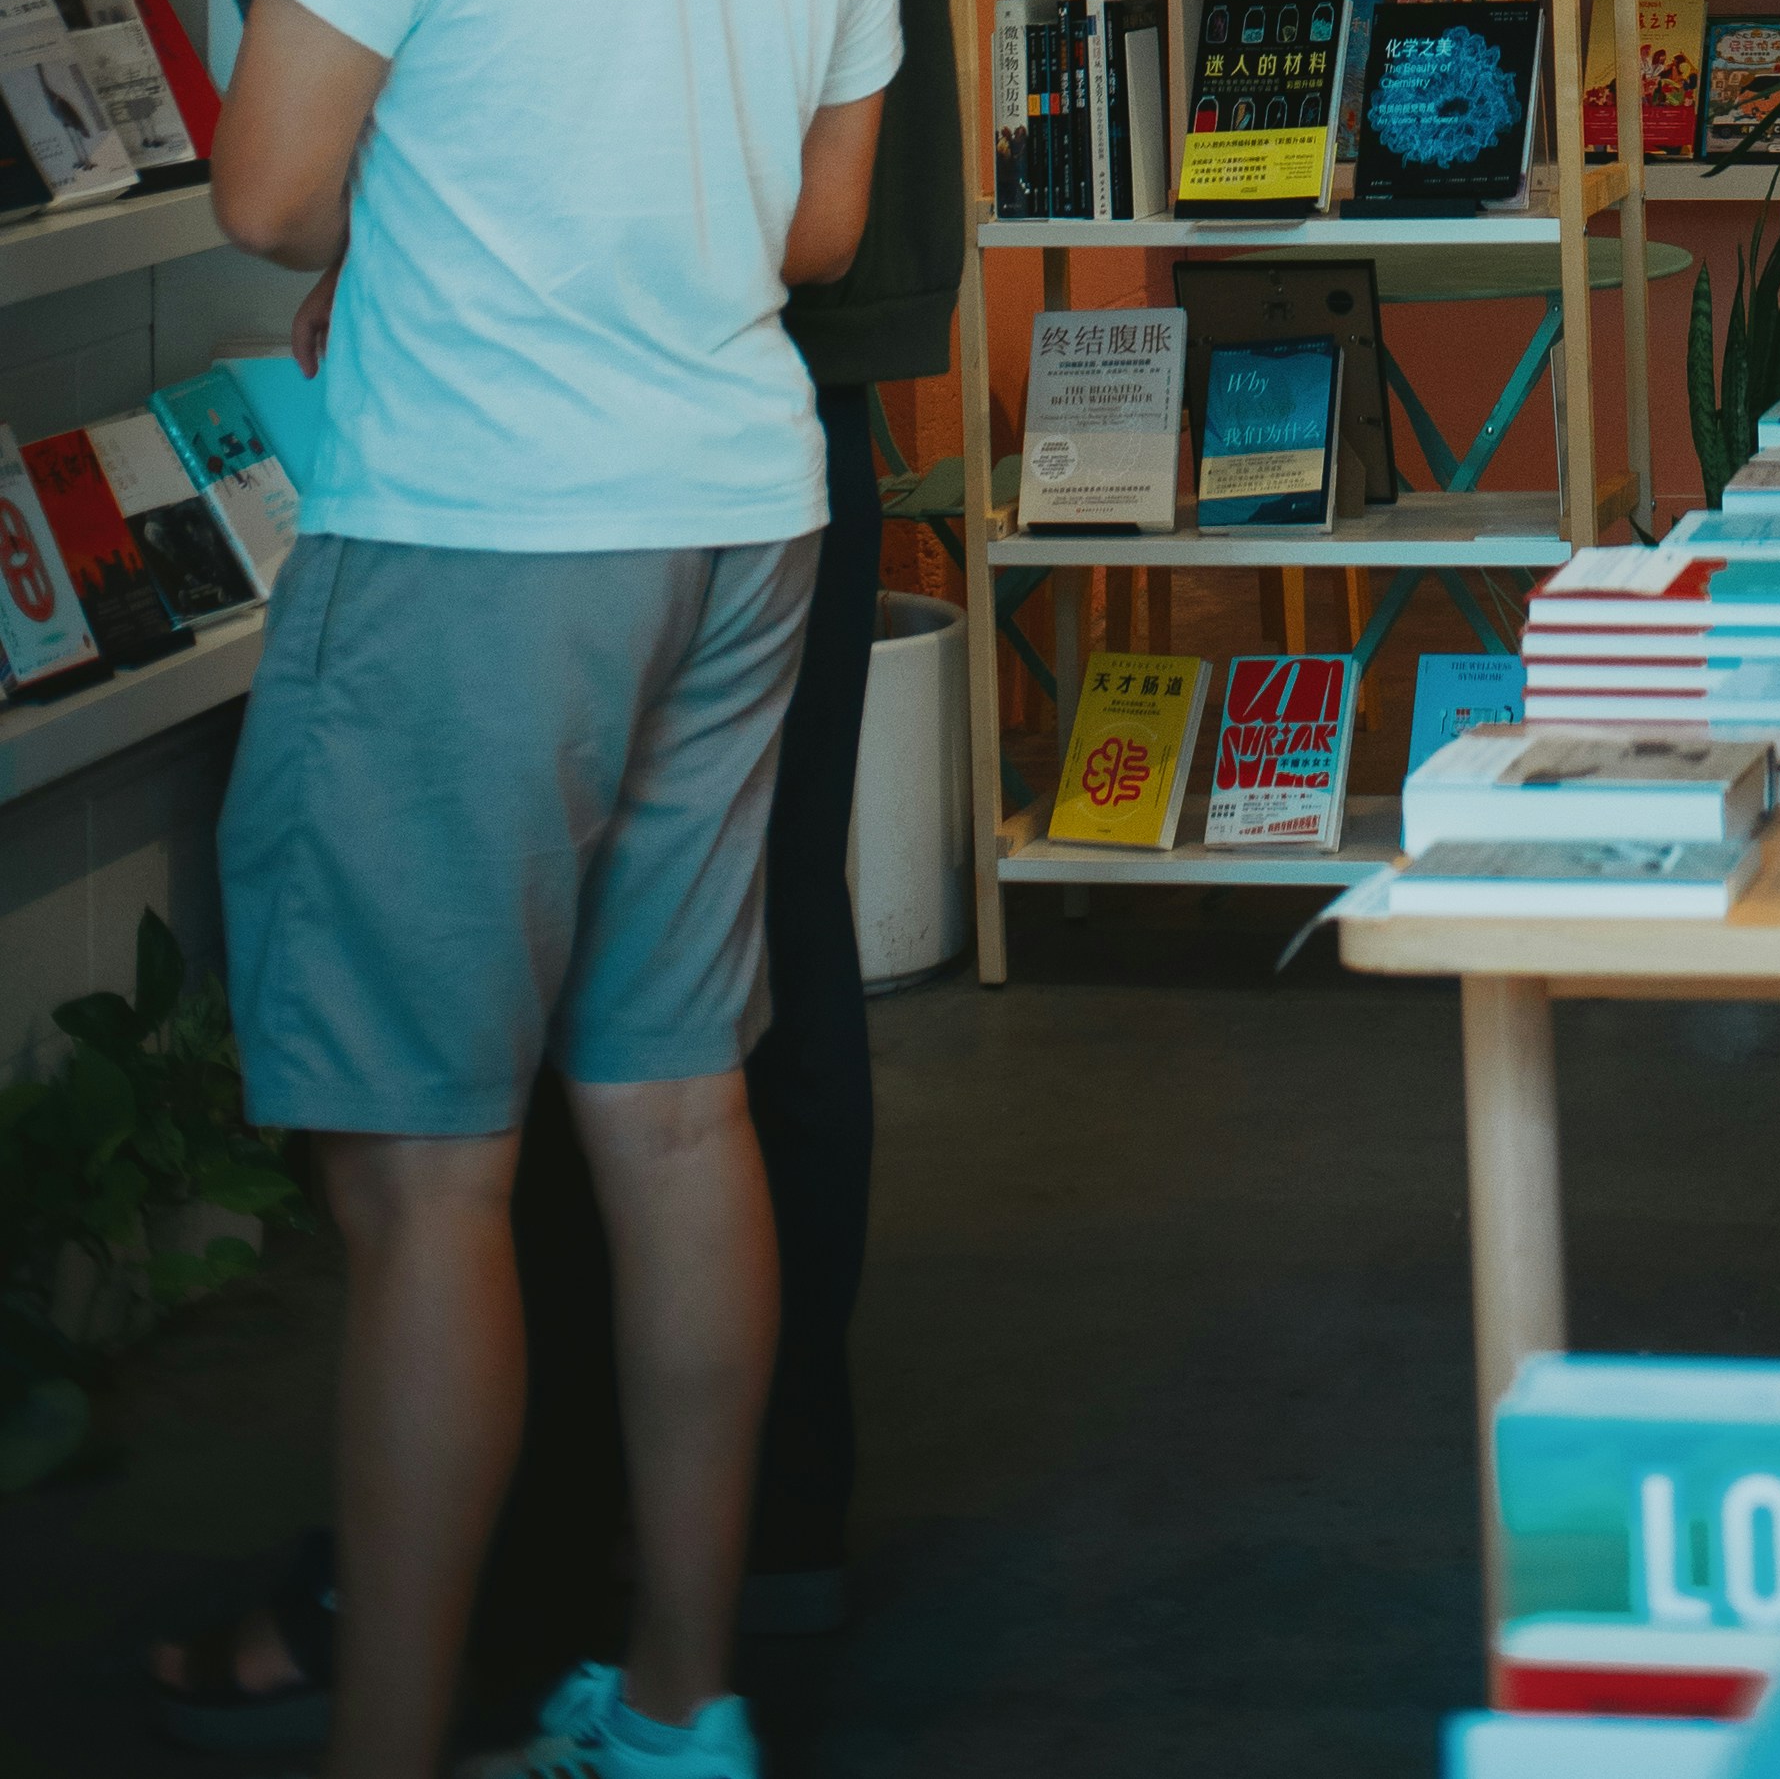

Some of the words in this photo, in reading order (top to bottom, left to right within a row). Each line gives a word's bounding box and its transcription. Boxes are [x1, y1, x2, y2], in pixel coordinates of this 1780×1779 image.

[1383, 35, 1449, 56] 化学之美
[1003, 25, 1020, 117] 微生物大历史
[1204, 51, 1326, 76] 迷人的材料
[1400, 58, 1432, 71] Beauty
[1436, 57, 1448, 69] of
[1379, 72, 1428, 86] Chemistry
[1041, 324, 1173, 357] 终结腹胀
[1226, 371, 1270, 399] Why
[1223, 419, 1321, 447] 我们为什么
[1450, 661, 1467, 671] THE
[1457, 672, 1504, 682] SYNDROME
[1091, 672, 1184, 697] 天才肠道
